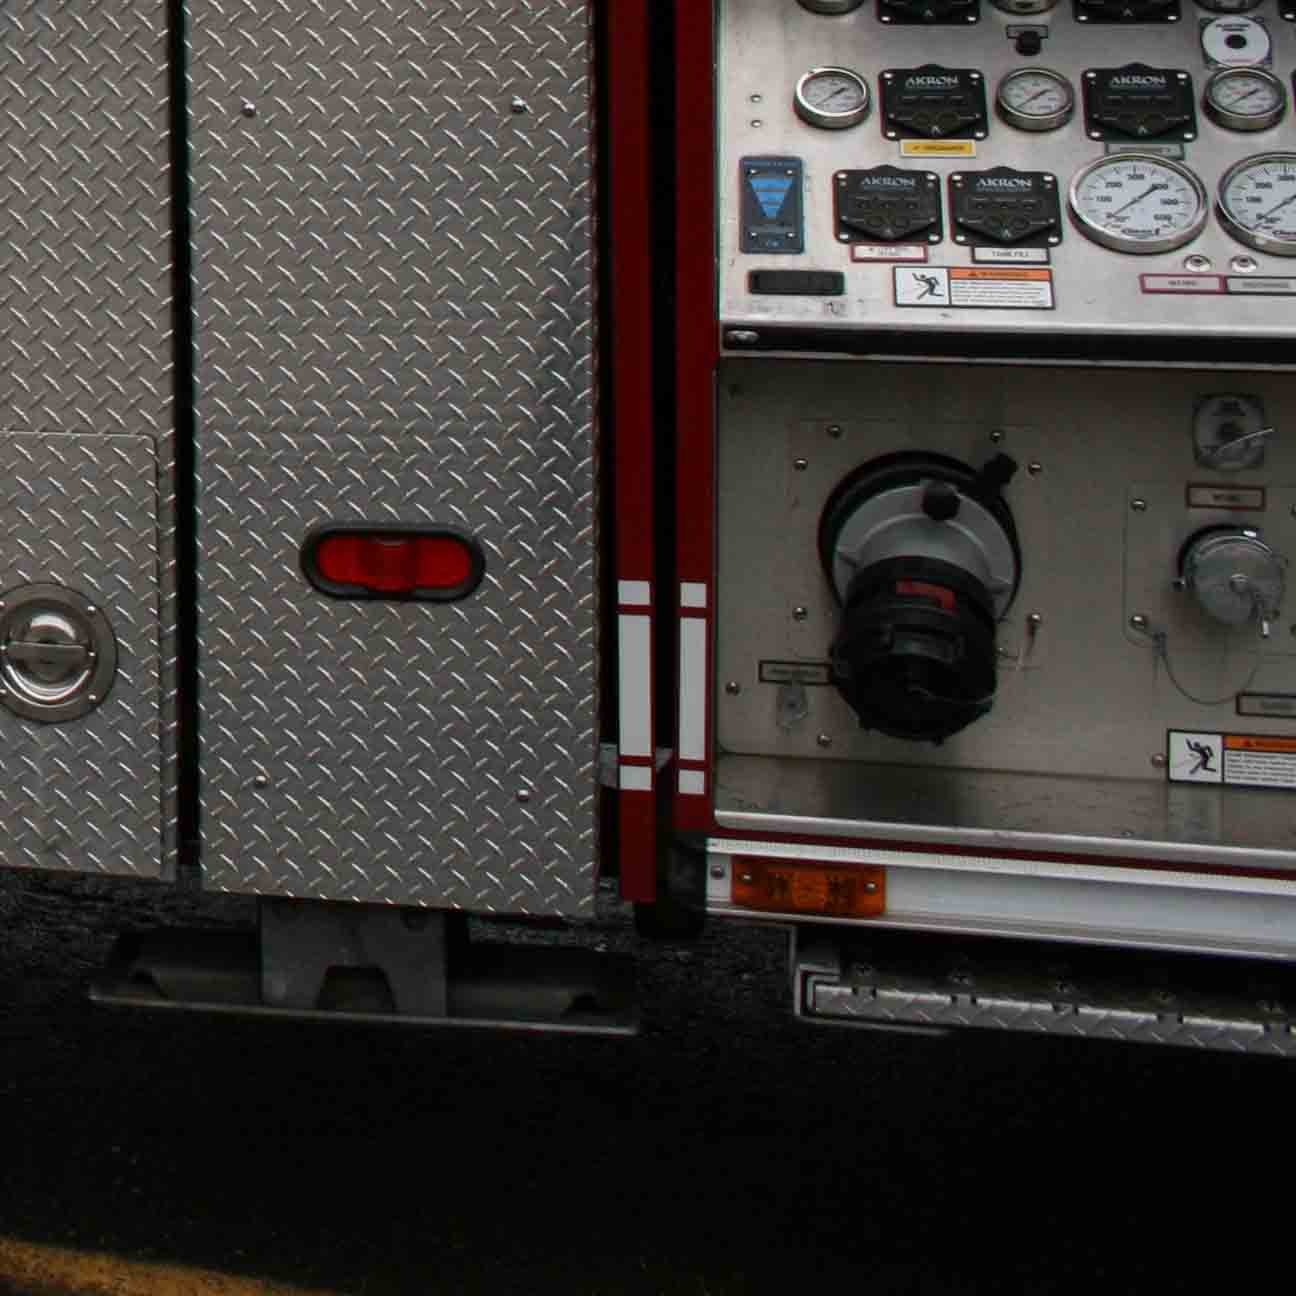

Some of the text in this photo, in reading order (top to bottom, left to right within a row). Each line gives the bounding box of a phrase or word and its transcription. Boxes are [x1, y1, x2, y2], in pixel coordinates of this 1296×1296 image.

[905, 75, 959, 89] AKRON
[1111, 73, 1167, 88] AKRON
[861, 176, 917, 190] AKRON
[975, 177, 1033, 191] AKRON
